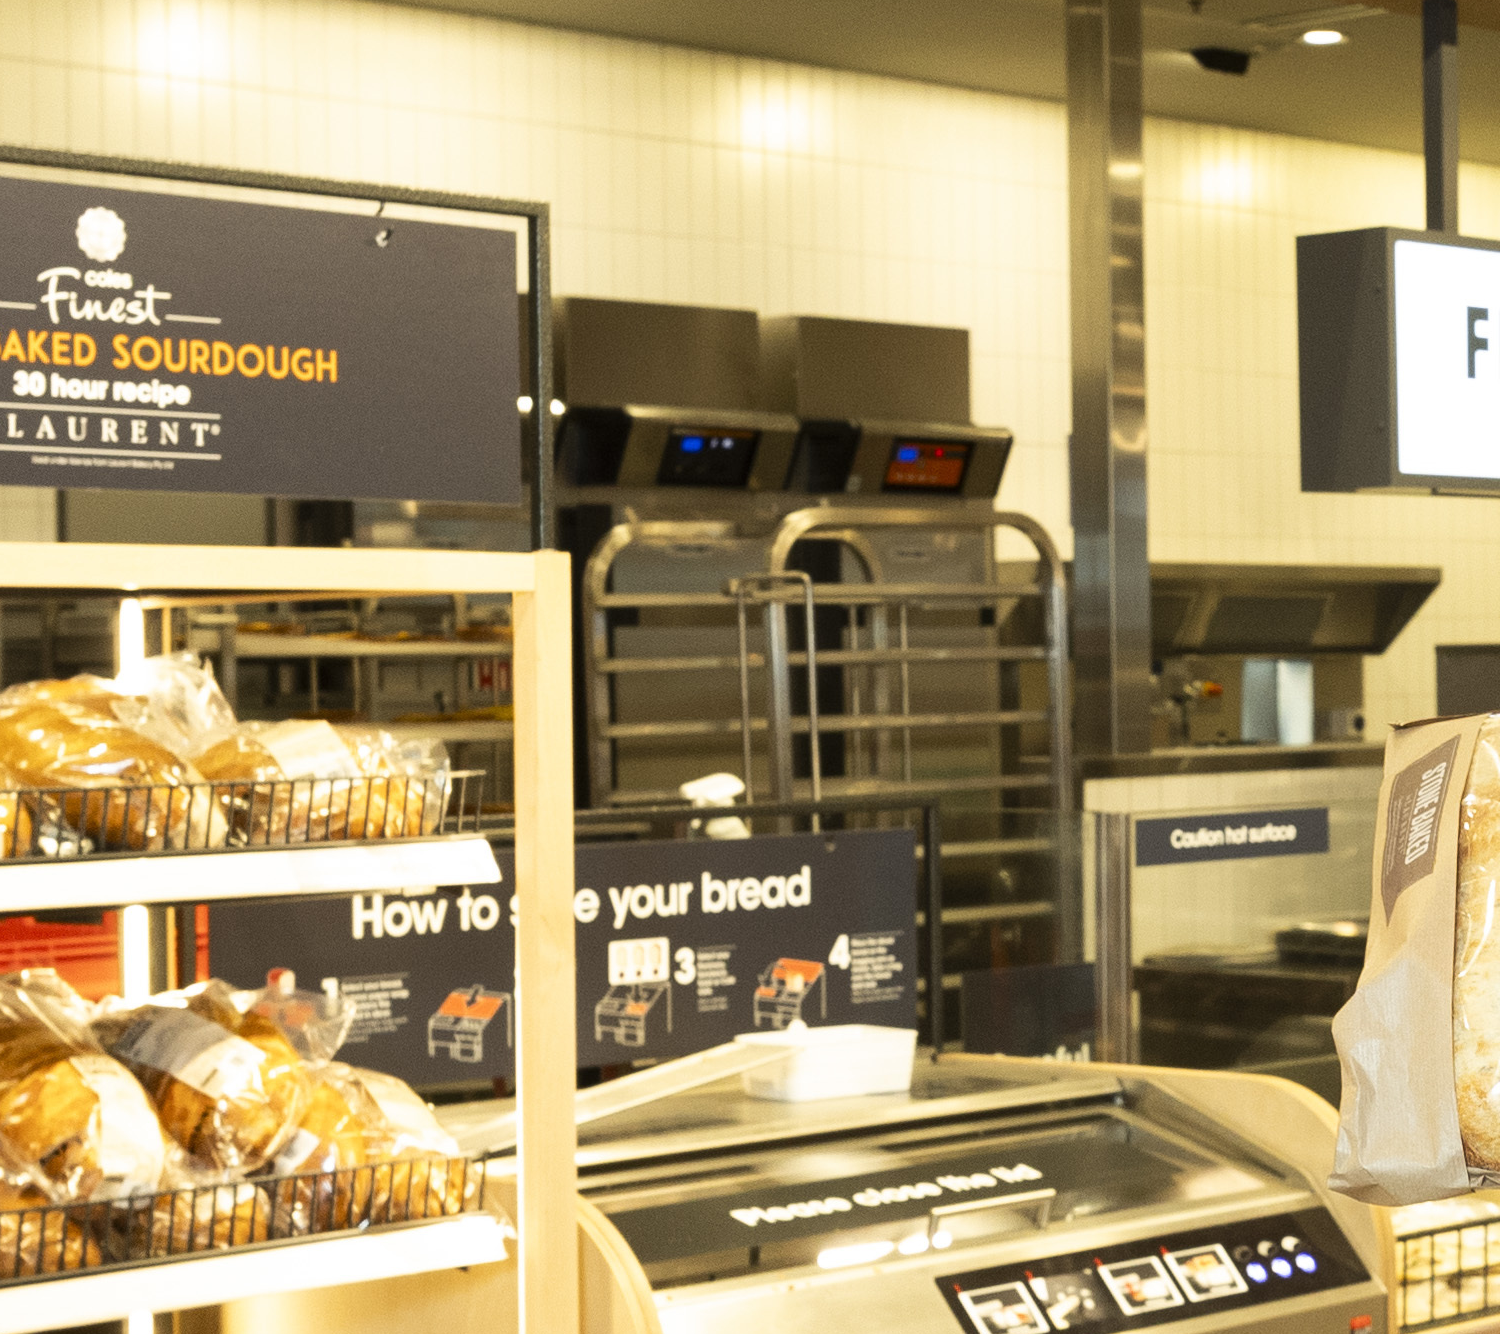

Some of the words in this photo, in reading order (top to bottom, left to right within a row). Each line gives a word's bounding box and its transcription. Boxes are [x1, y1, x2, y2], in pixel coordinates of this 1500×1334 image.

[37, 266, 172, 326] Finest
[112, 334, 338, 383] SOURDOUGH
[13, 370, 46, 398] 30
[51, 372, 108, 402] hour
[112, 378, 192, 409] recipe
[1414, 761, 1447, 815] STONE
[1170, 828, 1222, 850] Caution
[1224, 826, 1248, 847] hot
[1249, 823, 1297, 845] surface
[1404, 805, 1437, 866] BAKED
[351, 893, 449, 940] How
[456, 885, 500, 933] to
[608, 881, 693, 930] your
[701, 864, 811, 914] bread
[673, 946, 697, 985] 3
[828, 933, 850, 970] 4
[730, 1196, 852, 1227] Please
[853, 1187, 943, 1208] close
[936, 1173, 998, 1193] the
